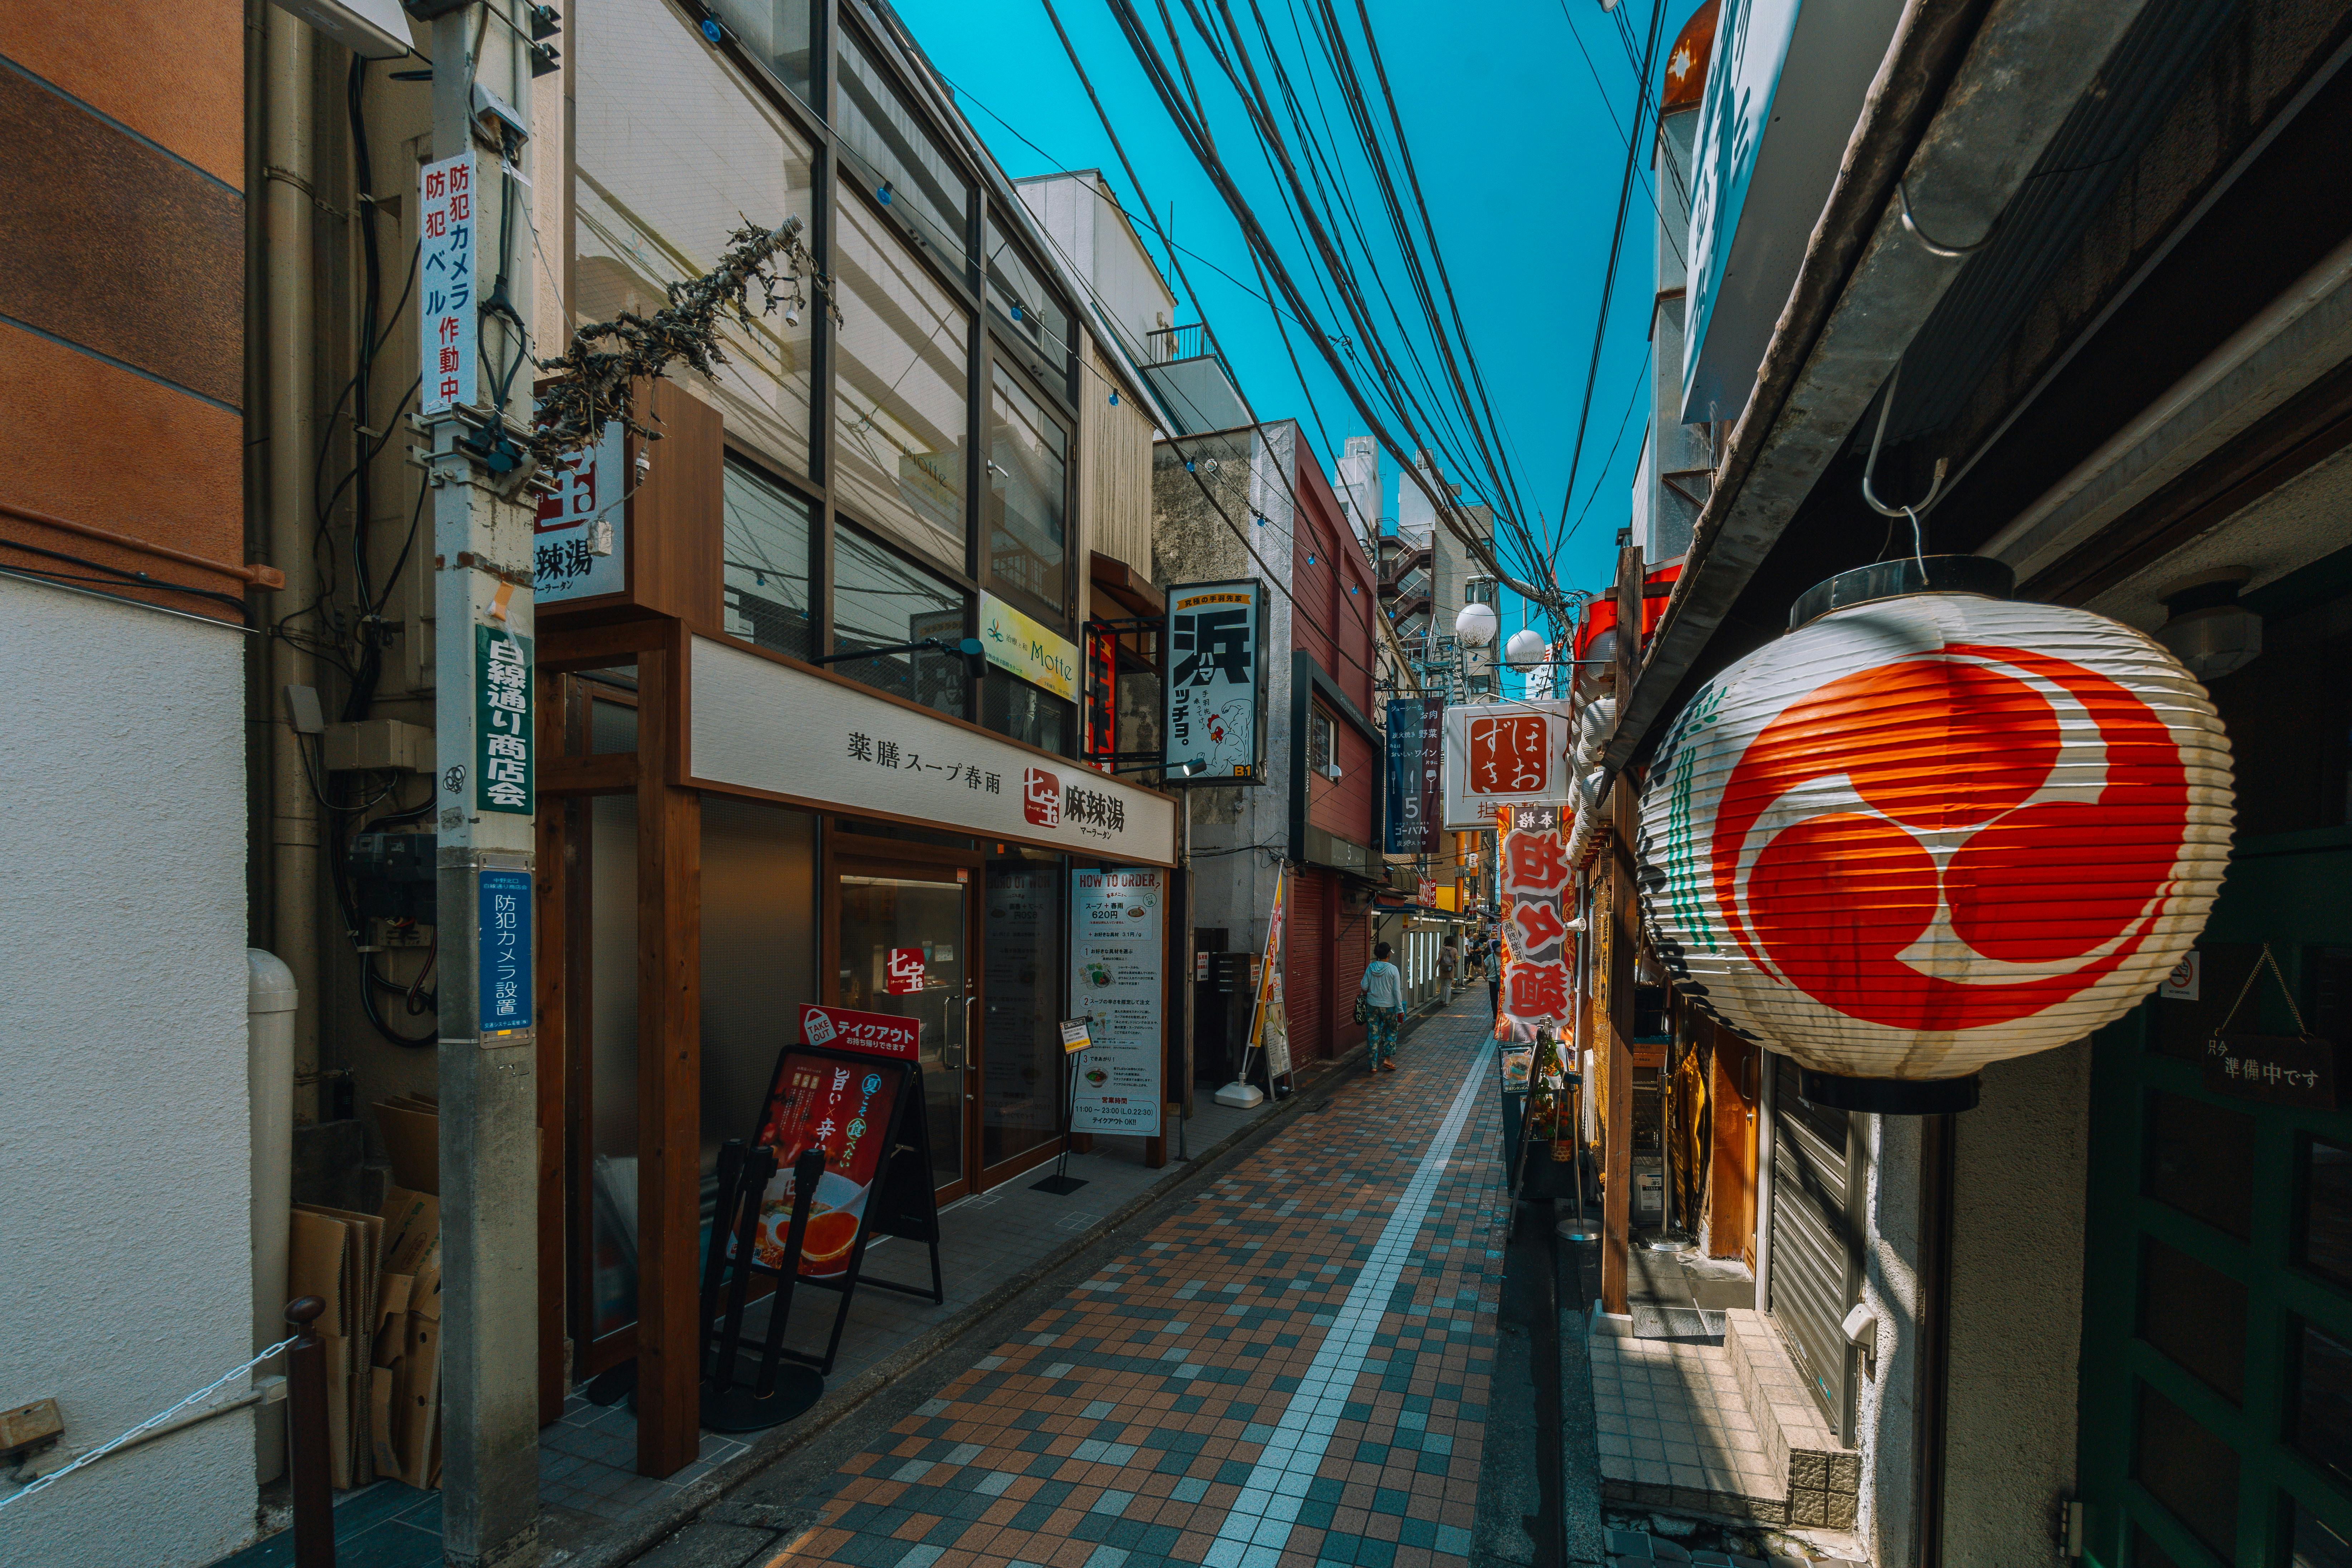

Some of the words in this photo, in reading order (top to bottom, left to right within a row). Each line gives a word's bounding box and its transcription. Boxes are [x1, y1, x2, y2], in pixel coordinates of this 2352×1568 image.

[450, 164, 470, 310] 防犯カメラ
[426, 172, 446, 317] 防犯ベル
[439, 316, 460, 403] 作動中
[534, 538, 593, 583] 辣湯
[1185, 595, 1243, 607] 究極の手羽先家
[1030, 640, 1072, 681] Motte
[1420, 710, 1438, 719] お肉
[487, 639, 526, 807] 白線通り商店会
[1419, 728, 1437, 738] 野菜
[1415, 748, 1437, 757] ワイン
[847, 731, 1001, 795] 薬膳スープ春雨
[1233, 765, 1251, 777] B1
[1064, 785, 1125, 834] 麻辣湯
[1405, 797, 1419, 819] 5
[1080, 826, 1112, 840] マーラータン
[1395, 825, 1429, 835] ゴーバル
[1080, 874, 1103, 888] HOW
[1106, 874, 1118, 888] TO
[1092, 910, 1118, 919] 620円
[495, 894, 518, 1016] 防犯カメラ設置
[807, 1020, 830, 1034] TAKE
[838, 1021, 914, 1044] テイクアウト
[812, 1030, 830, 1041] OUT
[846, 1037, 905, 1052] お持ち帰りできます
[2225, 1057, 2319, 1088] 準備中です
[1101, 1096, 1128, 1105] 営業時間
[1092, 1117, 1123, 1125] テイクアウト
